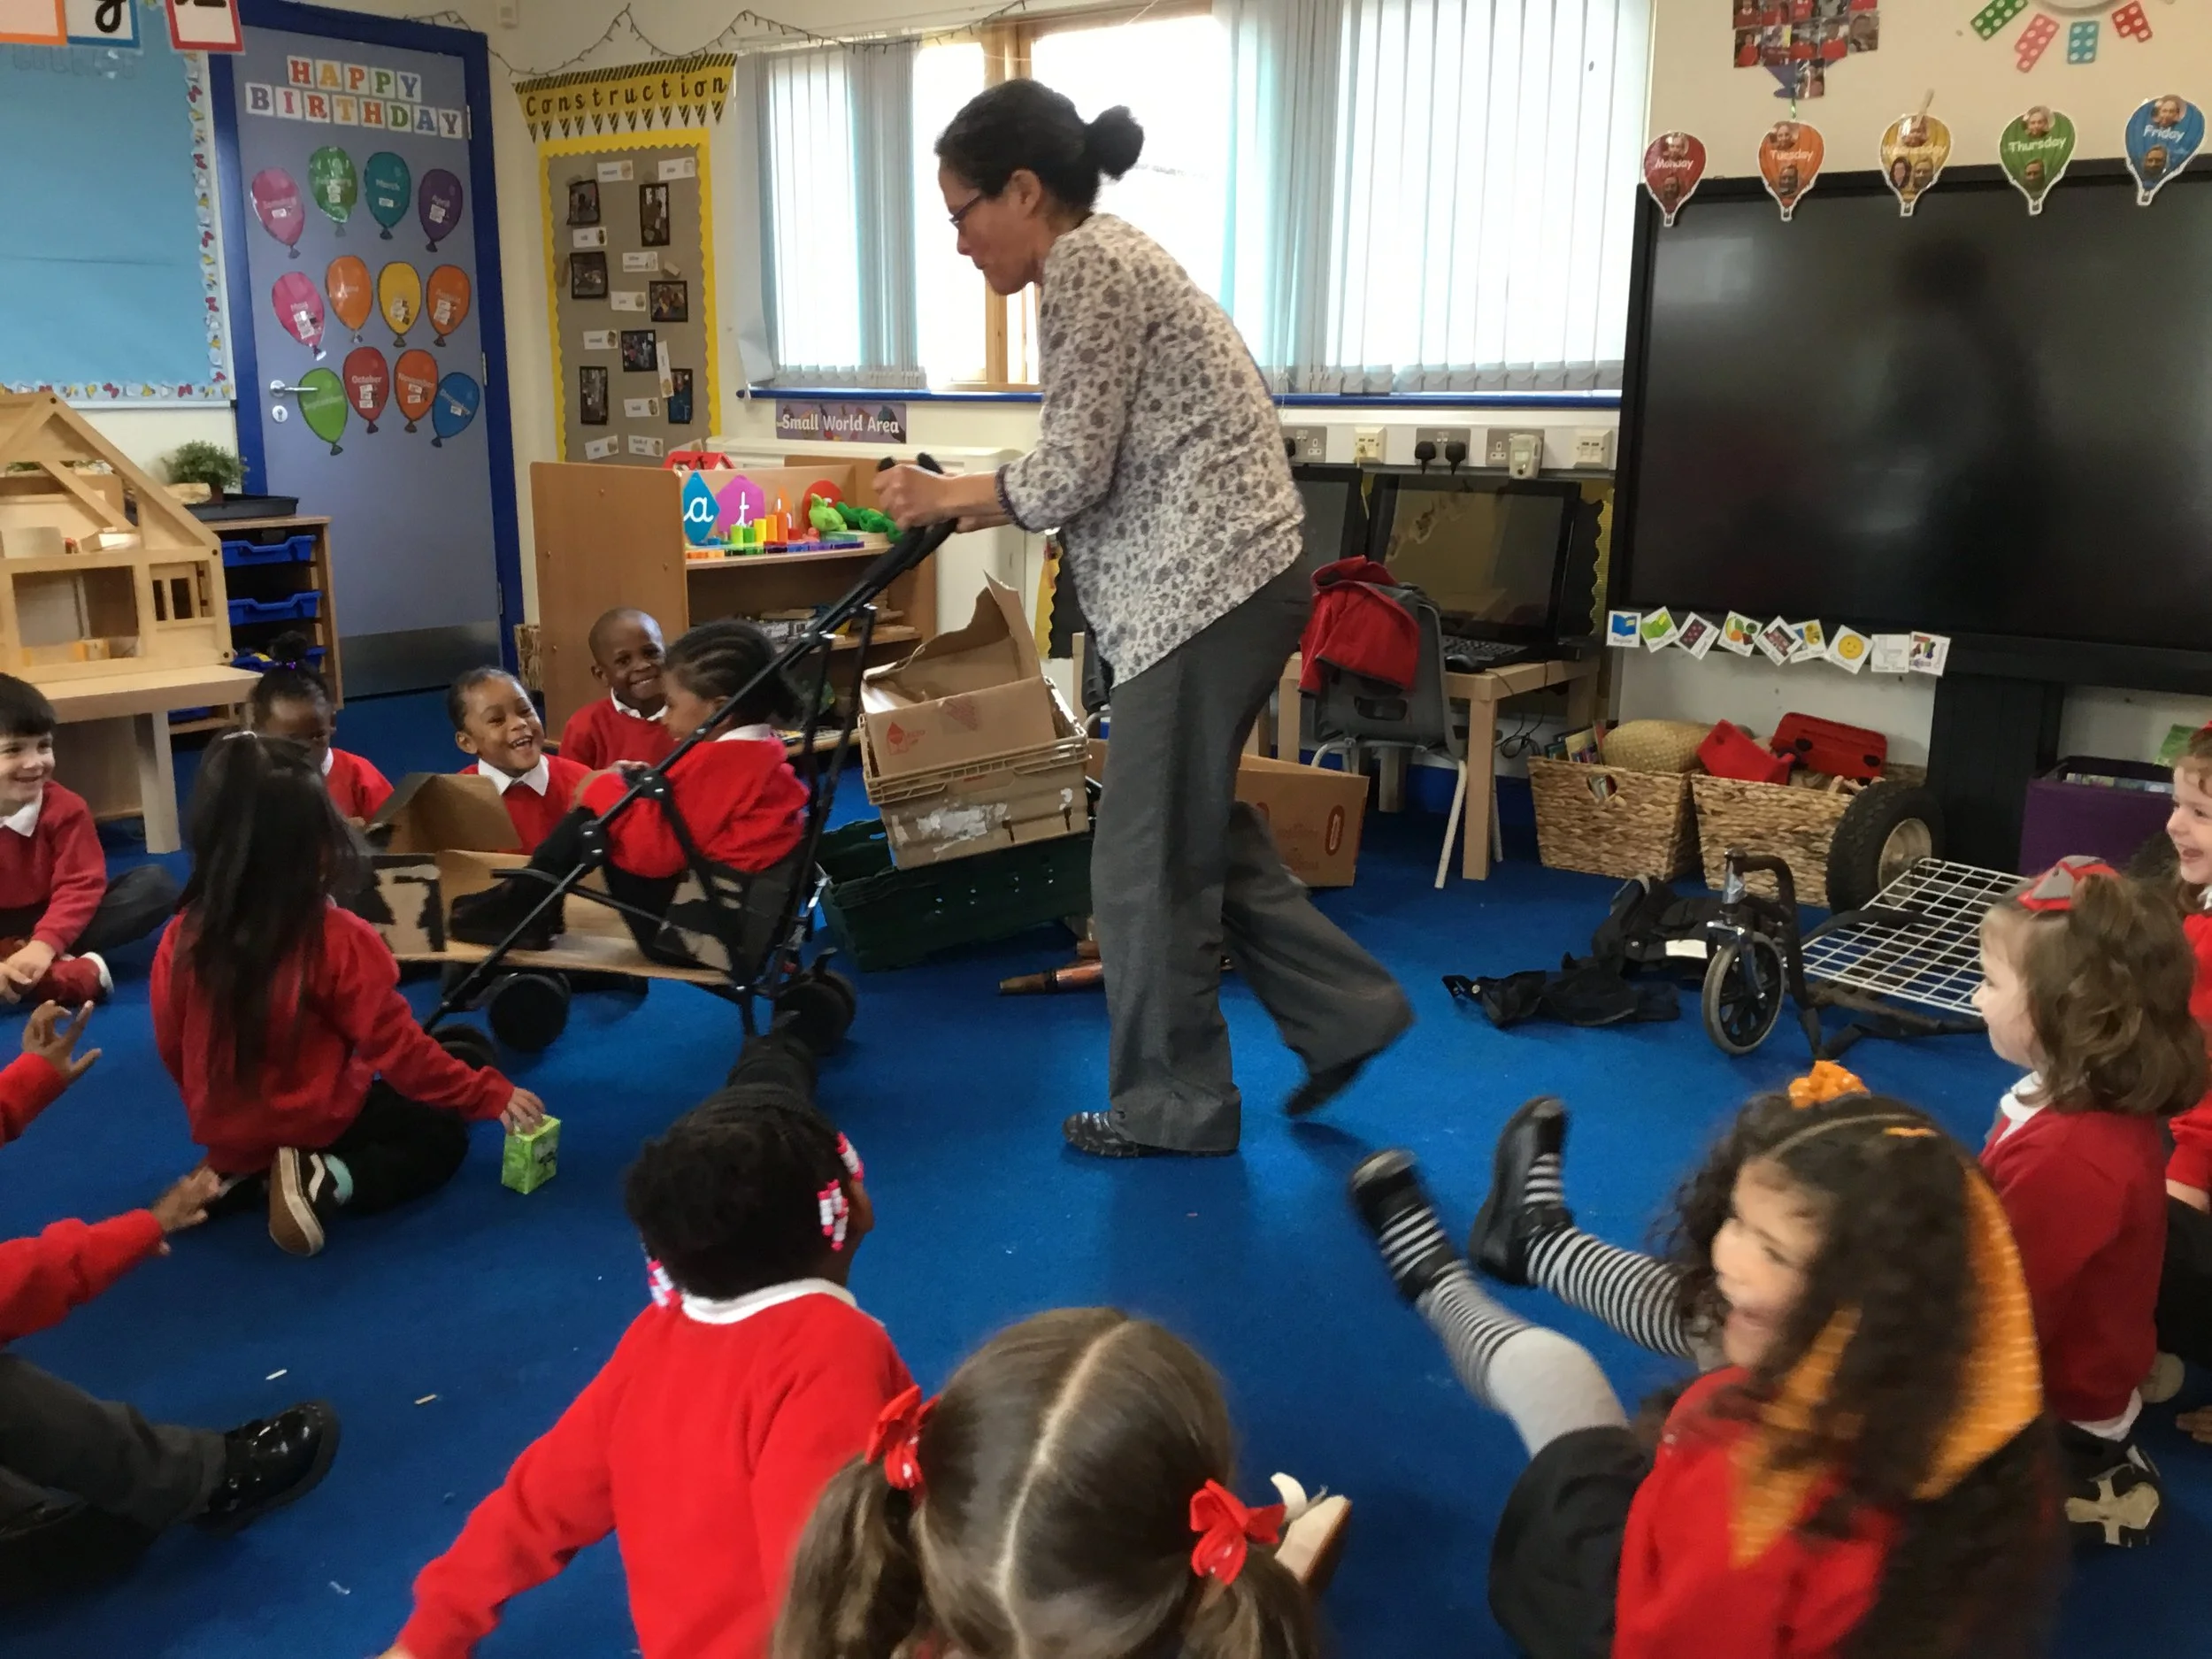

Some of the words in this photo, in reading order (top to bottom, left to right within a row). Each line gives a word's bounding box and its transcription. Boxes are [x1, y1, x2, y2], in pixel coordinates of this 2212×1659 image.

[289, 59, 418, 98] HAPPY
[526, 74, 727, 117] Construction
[250, 86, 458, 134] BIRTHDAY
[2143, 124, 2185, 143] Friday
[2008, 136, 2067, 153] Thursday
[1655, 157, 1694, 170] Monday
[1770, 149, 1814, 162] Tuesday
[351, 374, 383, 384] October
[397, 373, 435, 388] November
[782, 413, 819, 431] Small
[823, 414, 864, 432] World
[866, 416, 900, 434] Area
[683, 496, 714, 523] a
[735, 491, 752, 527] t
